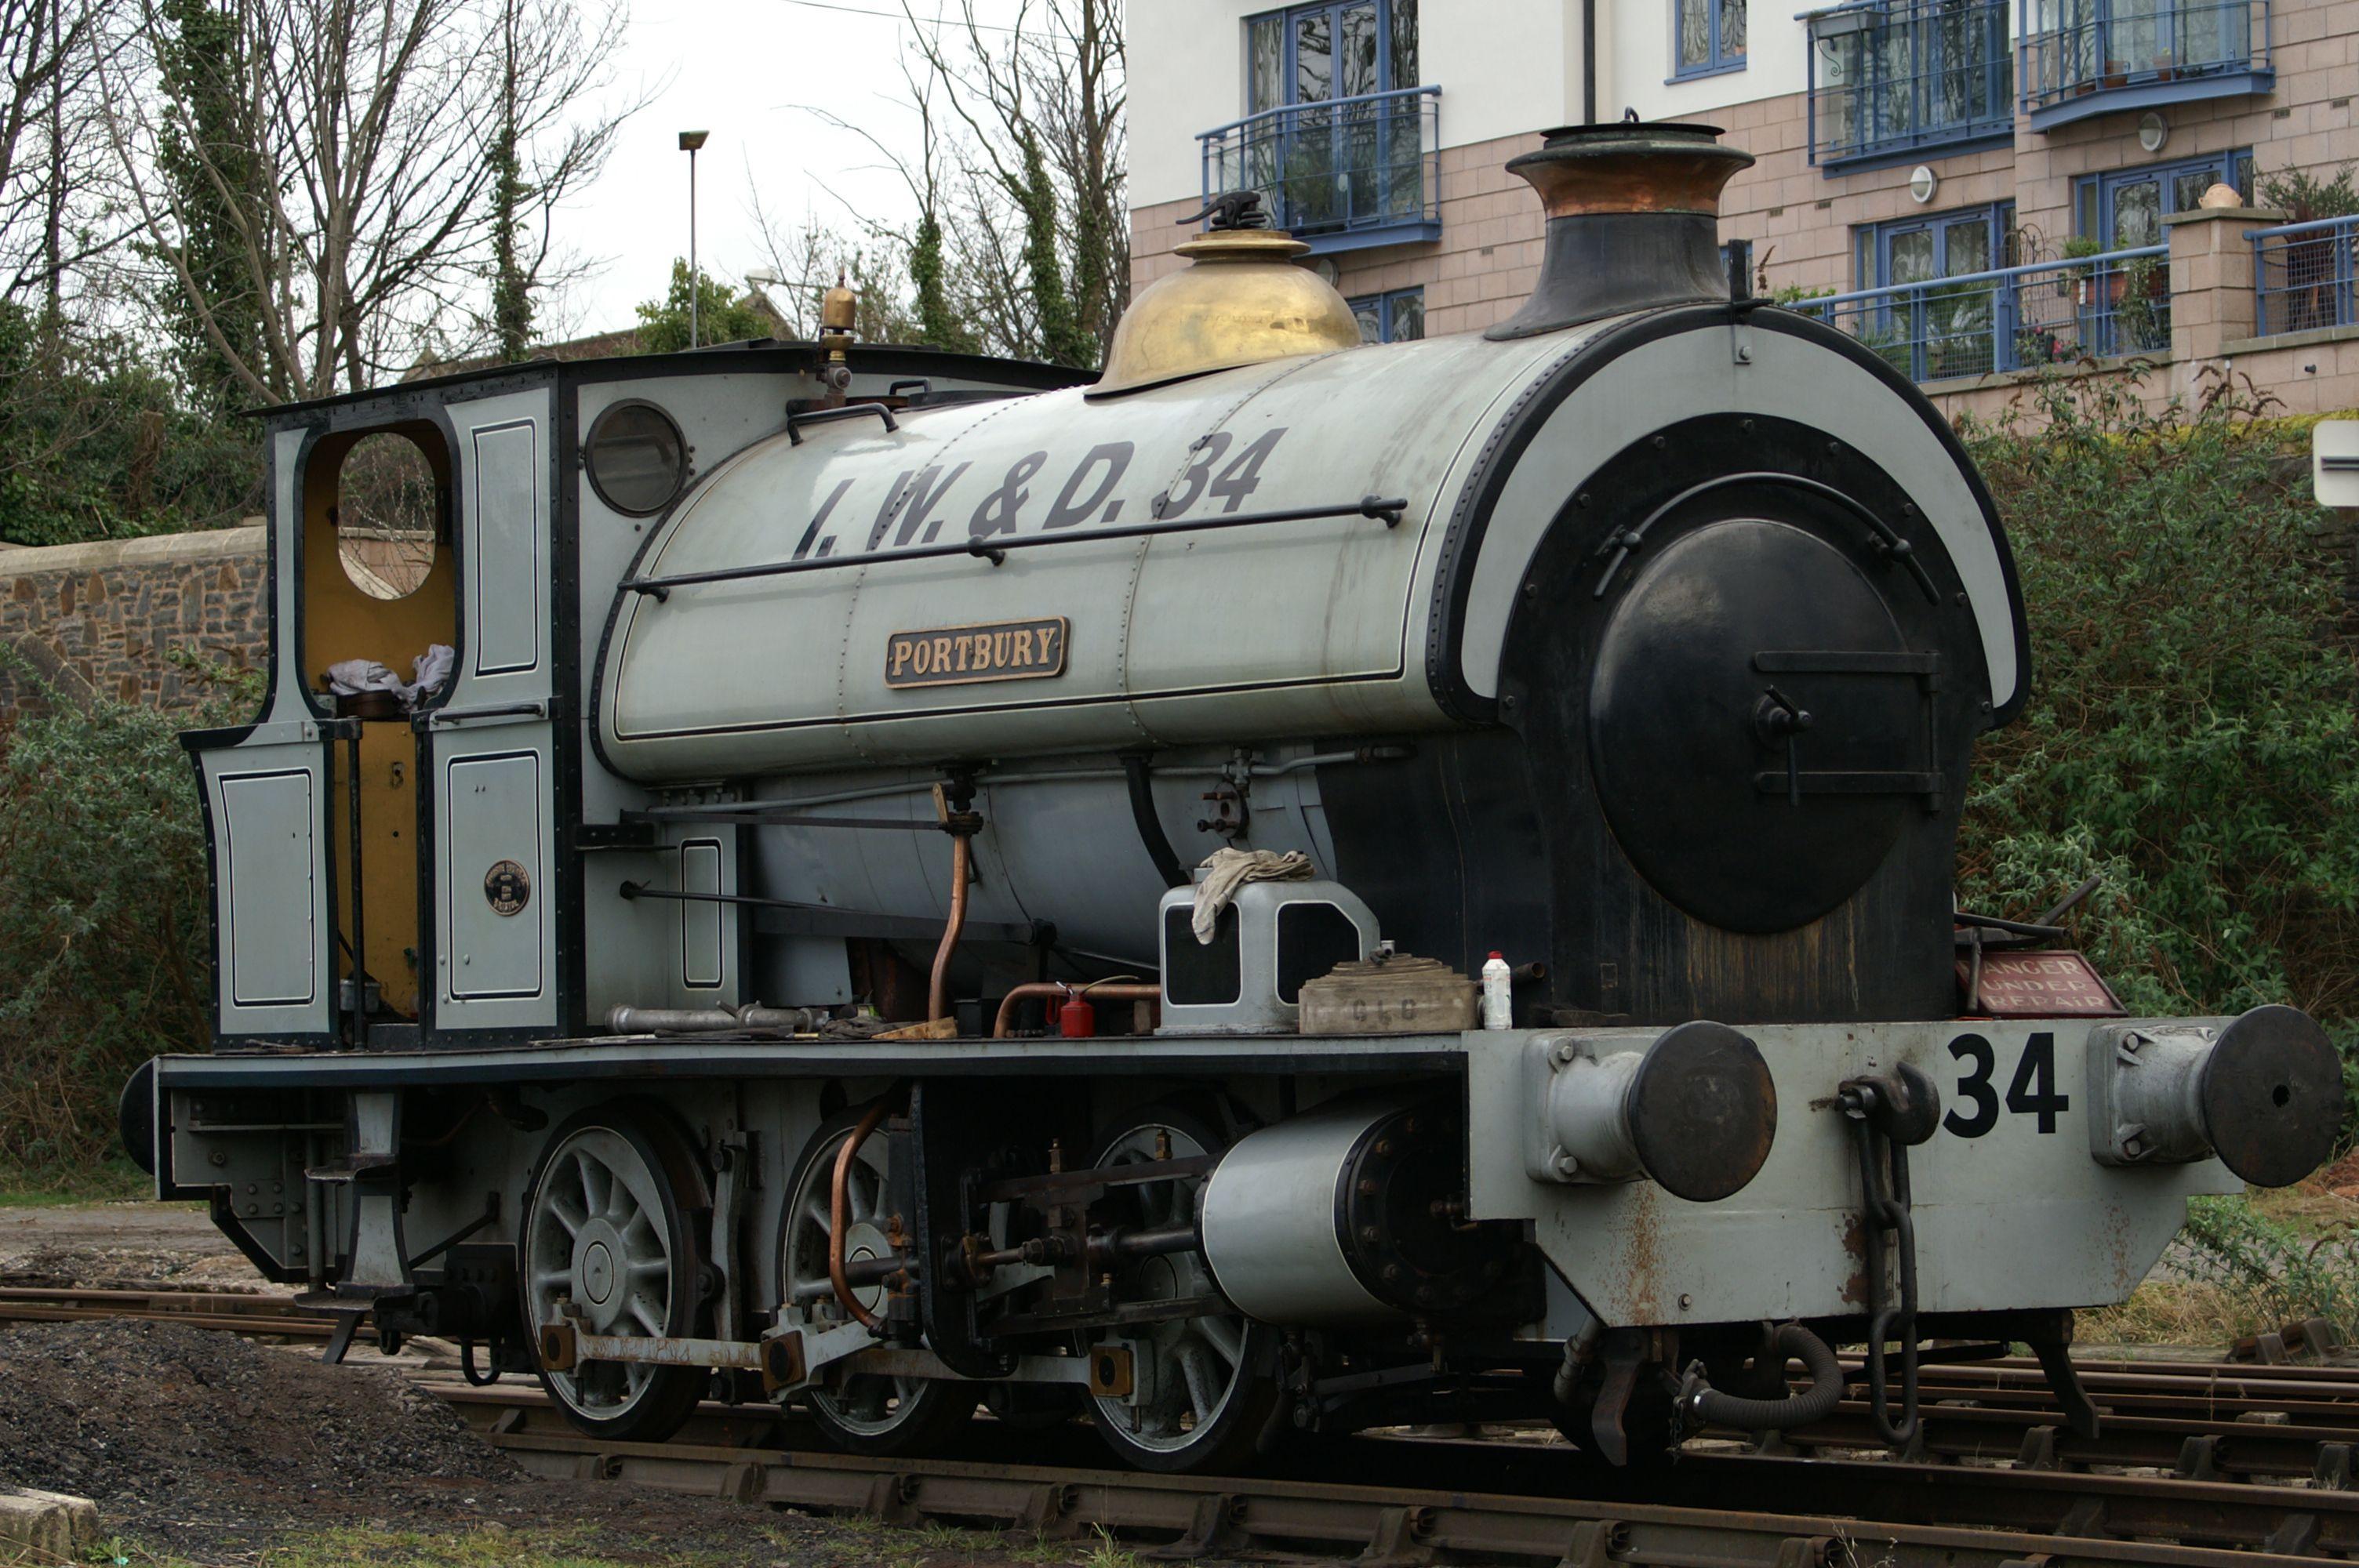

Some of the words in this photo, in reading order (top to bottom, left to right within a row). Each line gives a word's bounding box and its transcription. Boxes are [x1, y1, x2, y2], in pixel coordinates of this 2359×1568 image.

[968, 450, 1048, 539] &
[1041, 441, 1135, 530] D.
[1150, 426, 1290, 521] 34
[892, 627, 1057, 676] PORTBURY
[1982, 980, 2088, 992] UNDER
[1942, 1032, 2070, 1139] 34
